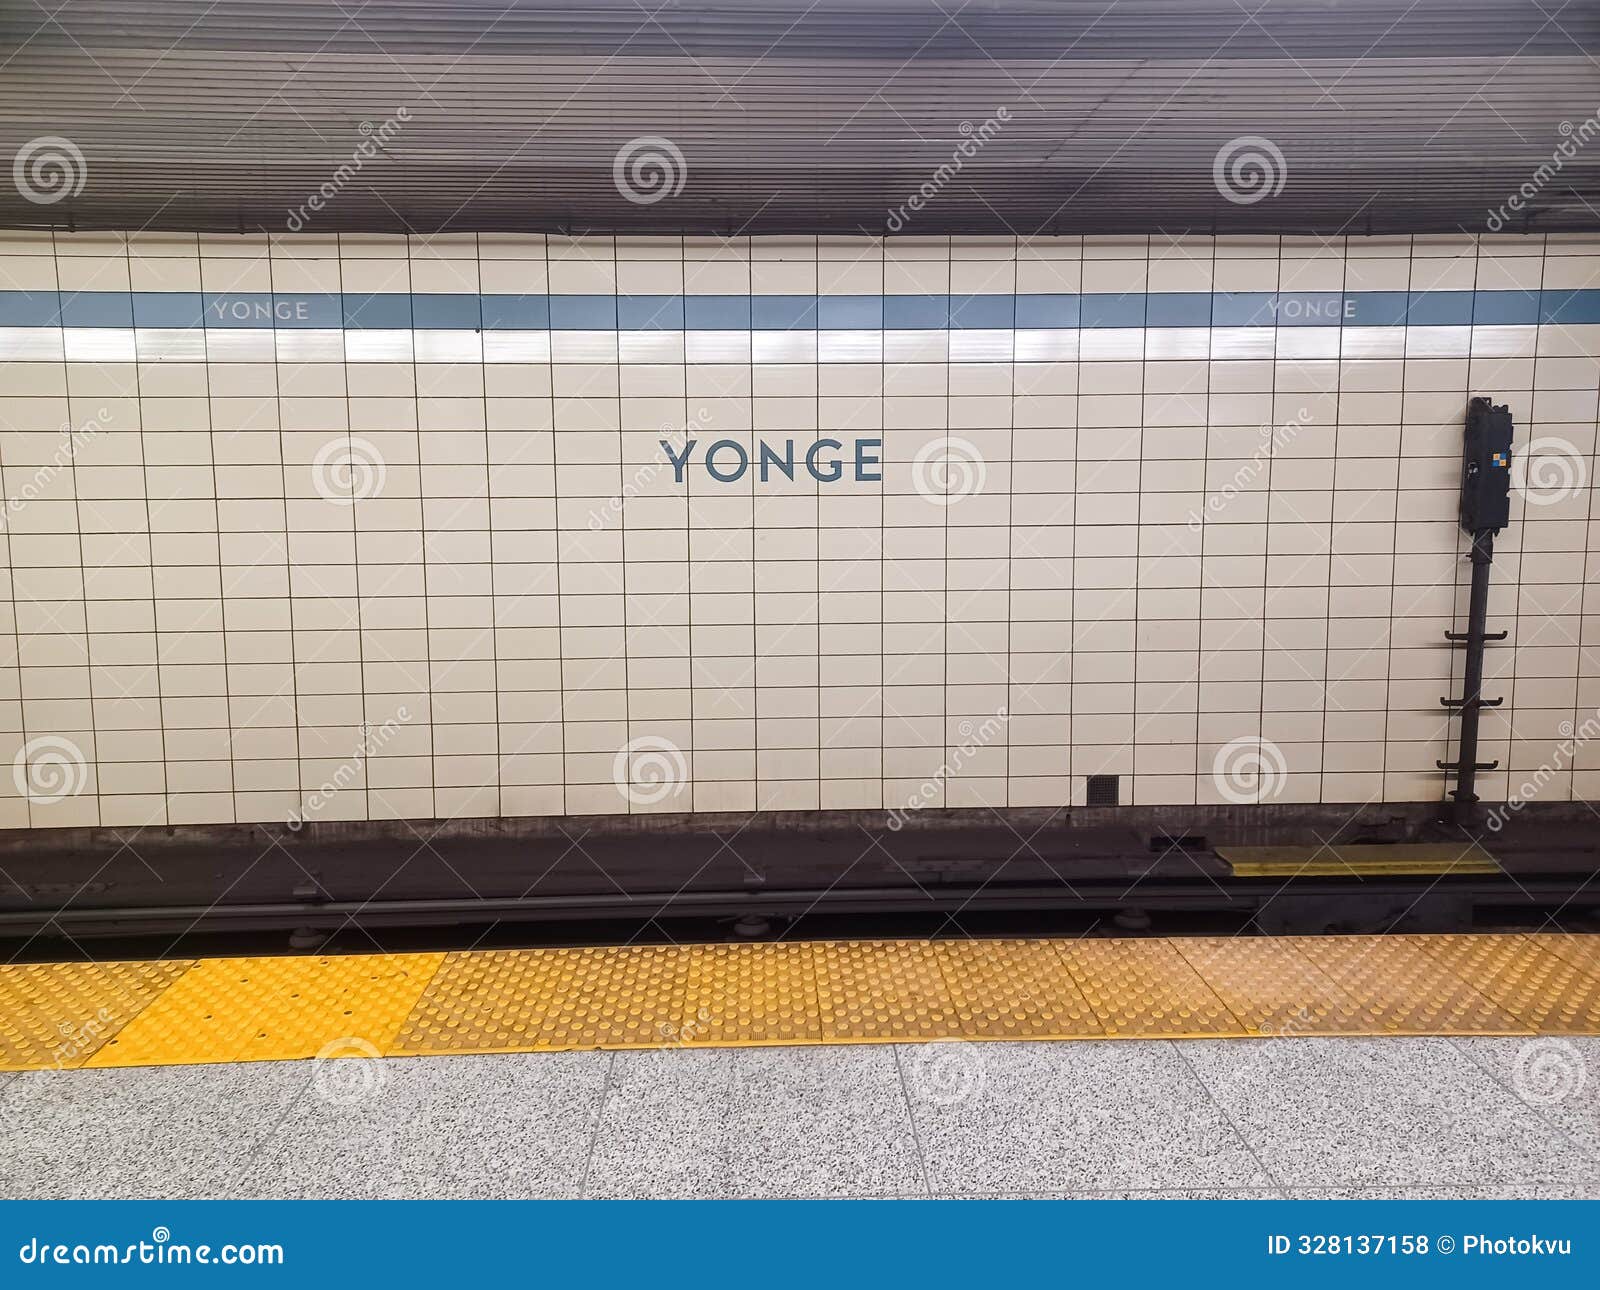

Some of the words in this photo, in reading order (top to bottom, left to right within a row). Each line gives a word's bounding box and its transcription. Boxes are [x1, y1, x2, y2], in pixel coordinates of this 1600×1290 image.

[213, 301, 309, 320] YONGE
[1267, 299, 1357, 318] YONGE
[659, 438, 882, 483] YONGE
